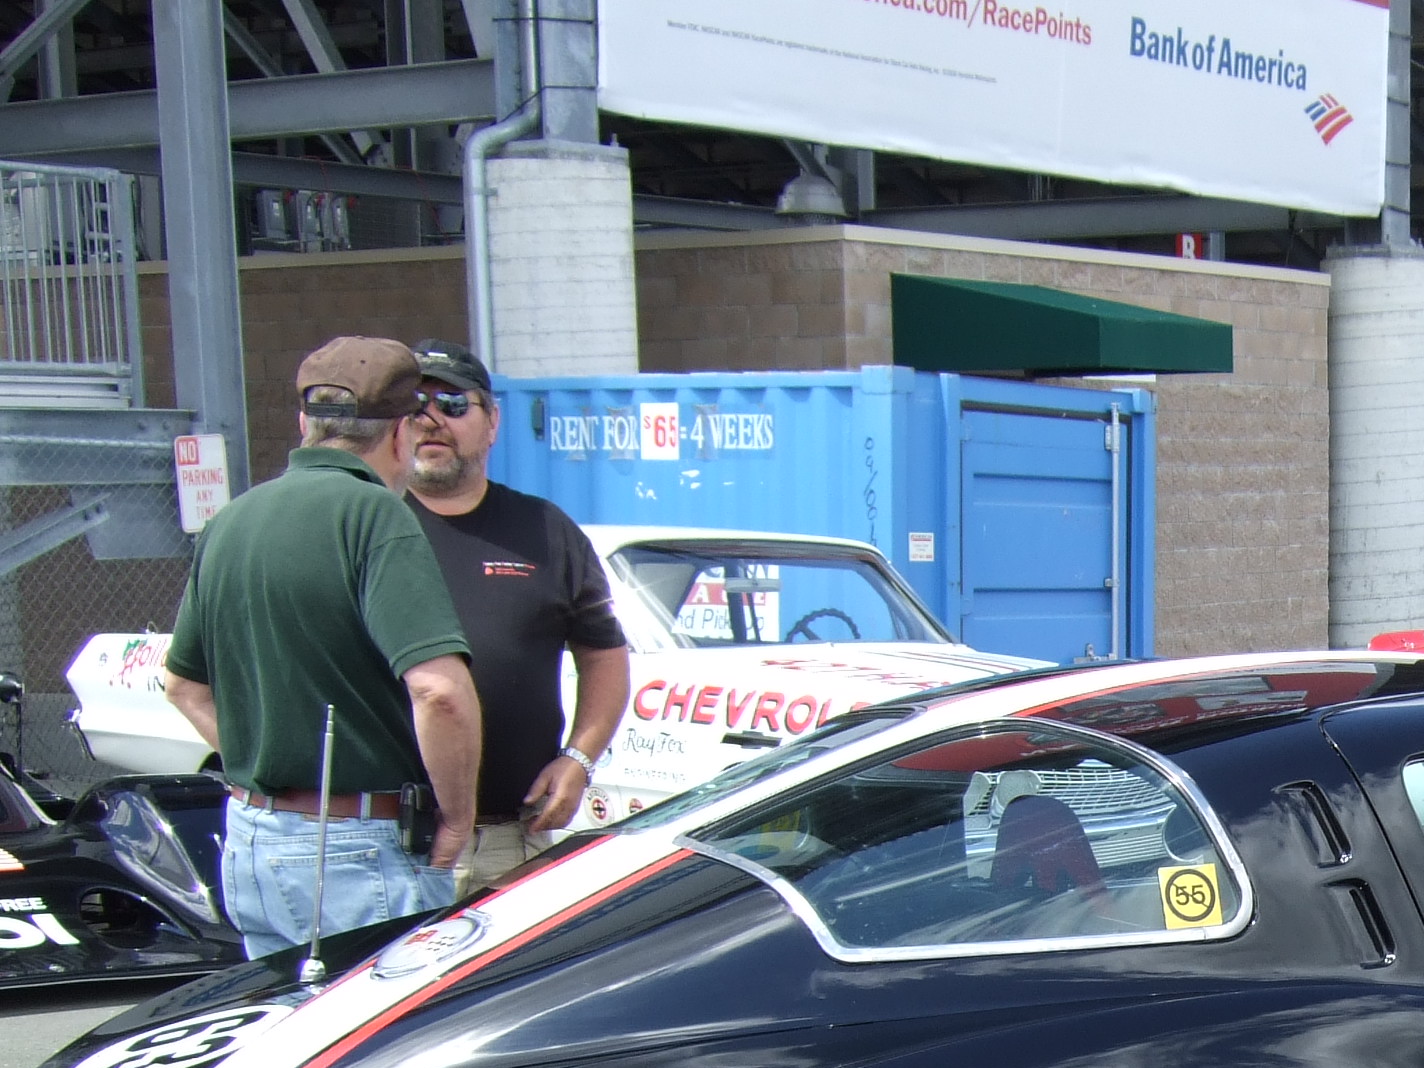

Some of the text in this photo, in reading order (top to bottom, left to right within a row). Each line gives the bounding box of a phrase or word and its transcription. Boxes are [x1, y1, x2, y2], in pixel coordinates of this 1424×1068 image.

[1129, 16, 1307, 91] Bank of America
[551, 415, 599, 450] RENT
[603, 415, 638, 450] FOR
[643, 414, 677, 448] $65
[708, 414, 774, 449] WEEKS
[179, 441, 197, 462] NO
[182, 468, 224, 486] PARKING
[196, 490, 213, 503] ANY
[633, 678, 873, 736] CHEVROL
[1175, 884, 1206, 906] 55
